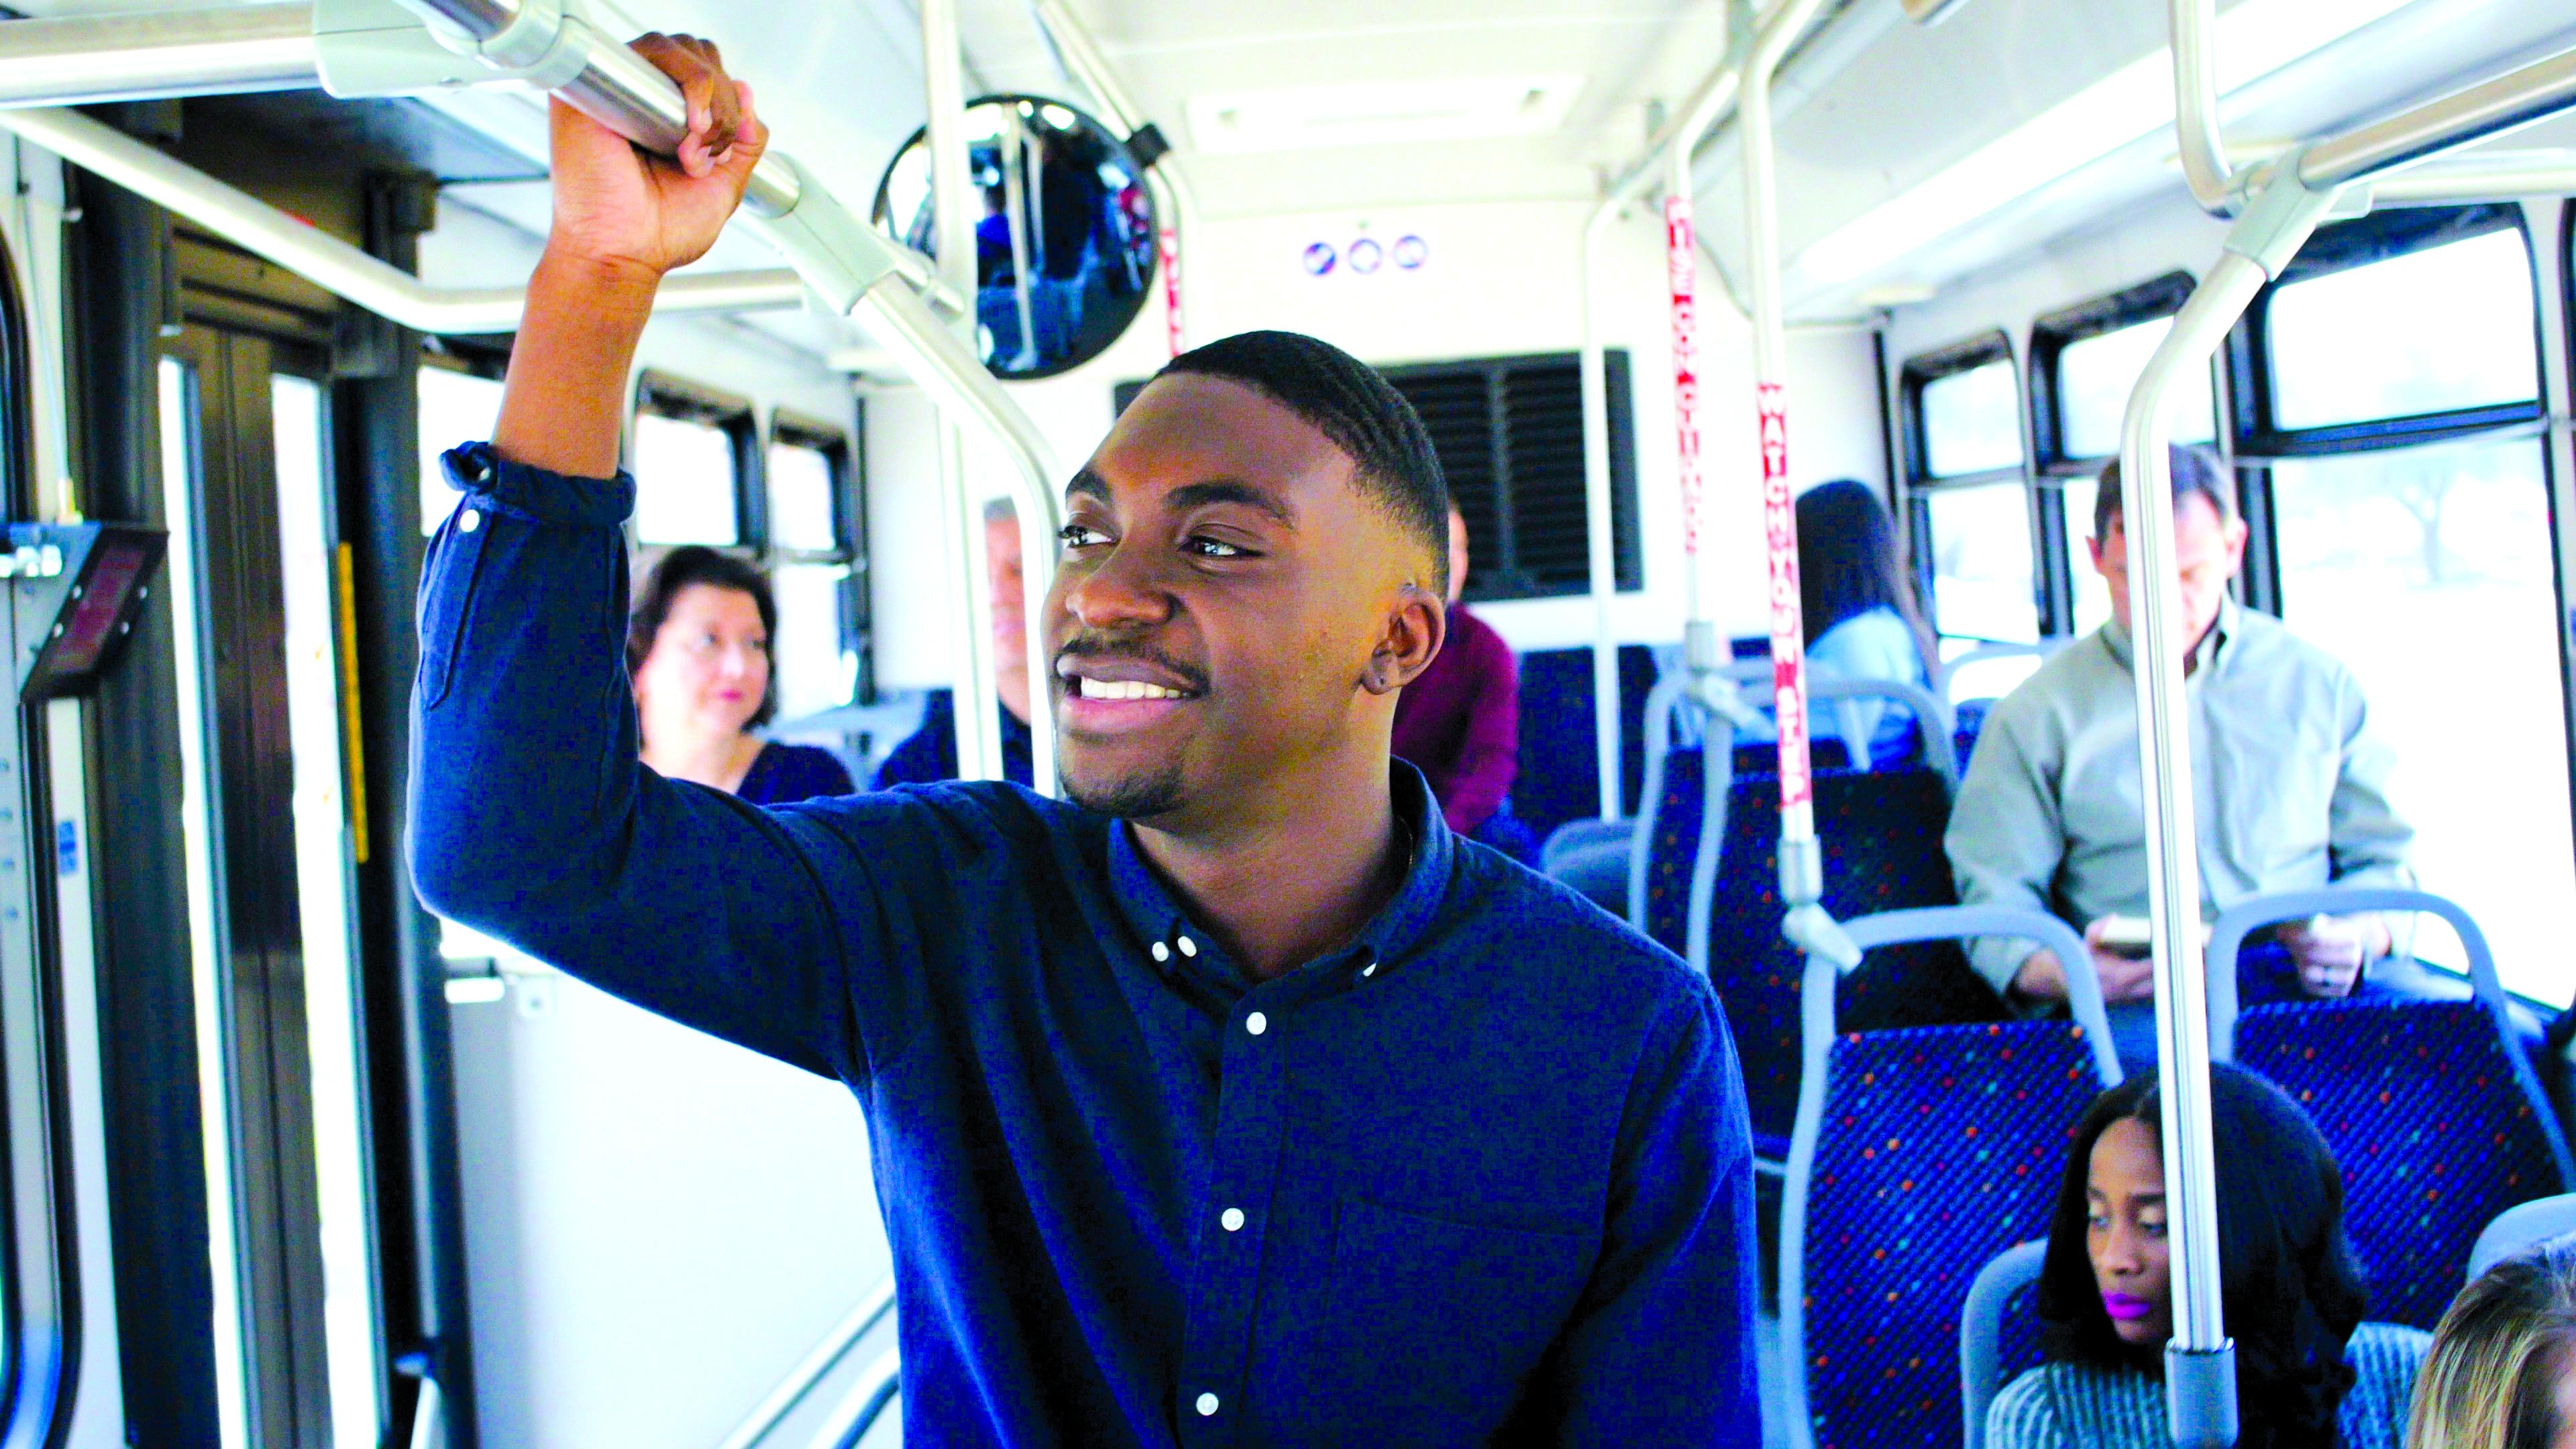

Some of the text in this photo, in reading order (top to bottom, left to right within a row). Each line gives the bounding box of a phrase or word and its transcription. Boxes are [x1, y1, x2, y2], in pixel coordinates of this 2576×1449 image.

[1756, 386, 1805, 802] WATCH YOUR STEP
